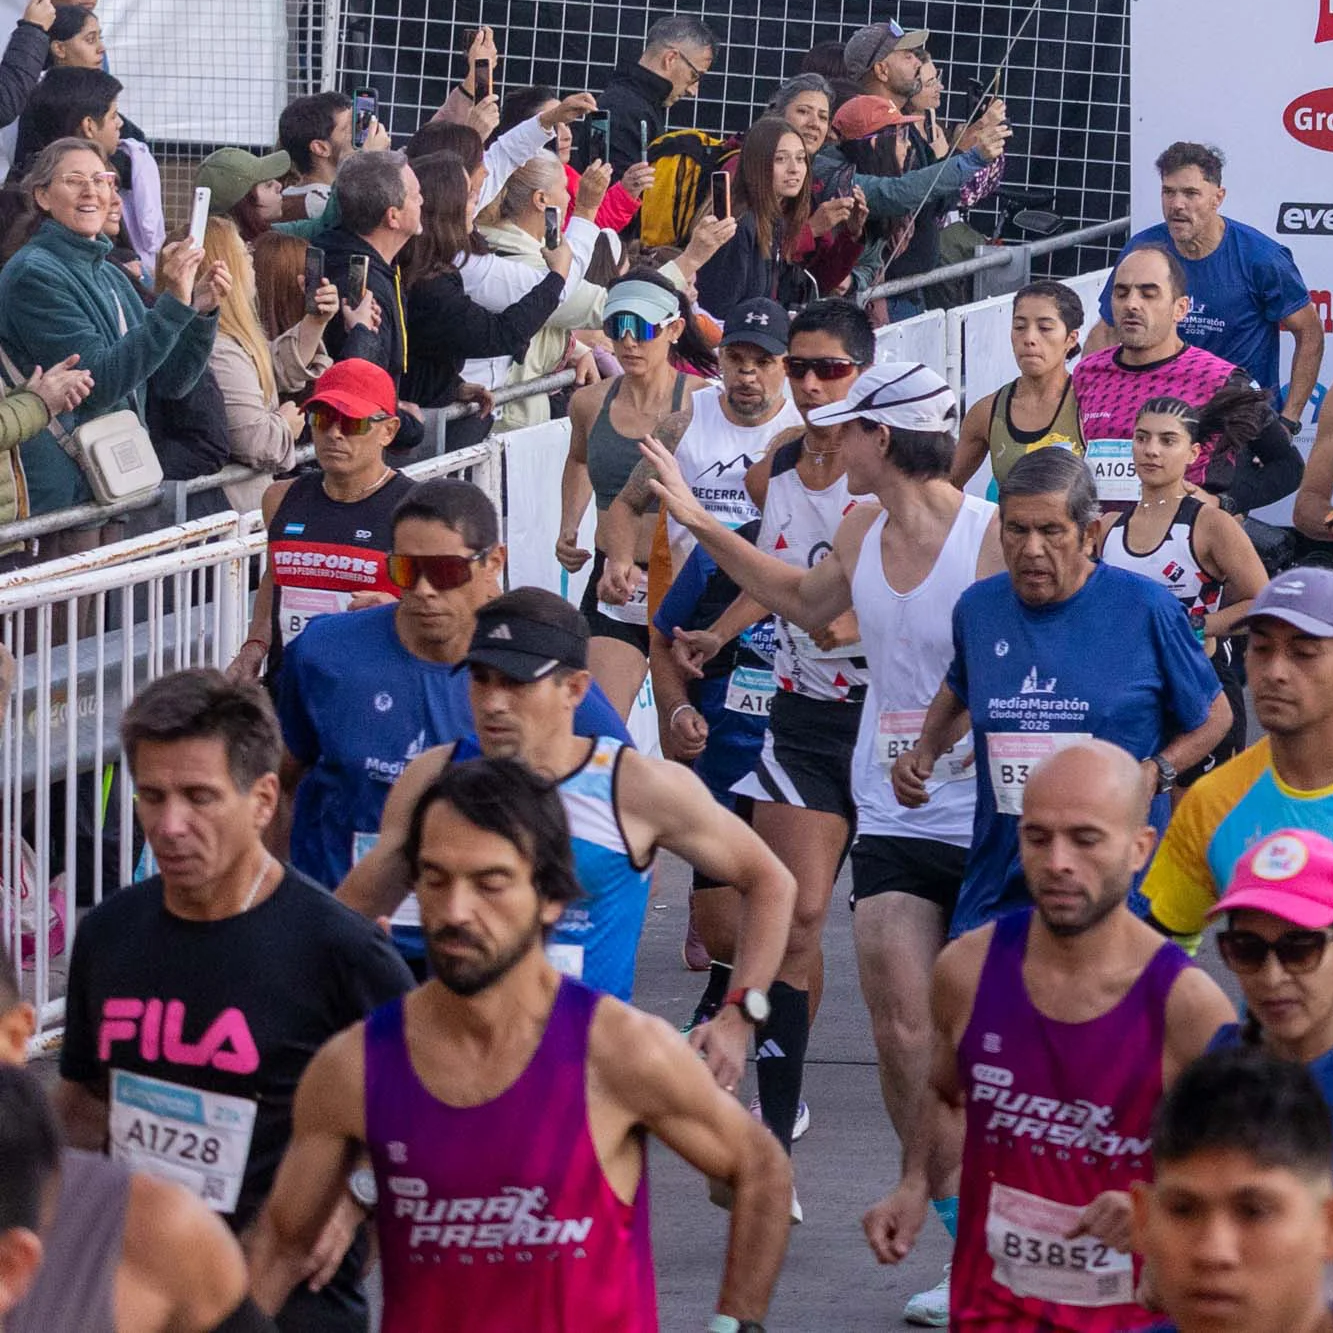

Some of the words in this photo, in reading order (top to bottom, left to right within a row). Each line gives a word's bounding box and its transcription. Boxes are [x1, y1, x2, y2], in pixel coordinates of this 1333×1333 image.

[1095, 462, 1135, 478] A105
[704, 504, 743, 515] RUNNING
[745, 507, 762, 517] TEA
[989, 697, 1089, 712] MediaMaratón
[991, 709, 1019, 720] Ciudad
[1022, 710, 1033, 720] de
[1035, 711, 1084, 721] Mendoza
[1020, 721, 1050, 731] 2026
[98, 998, 260, 1076] FILA
[127, 1118, 222, 1165] A1728
[1003, 1232, 1109, 1270] B3852
